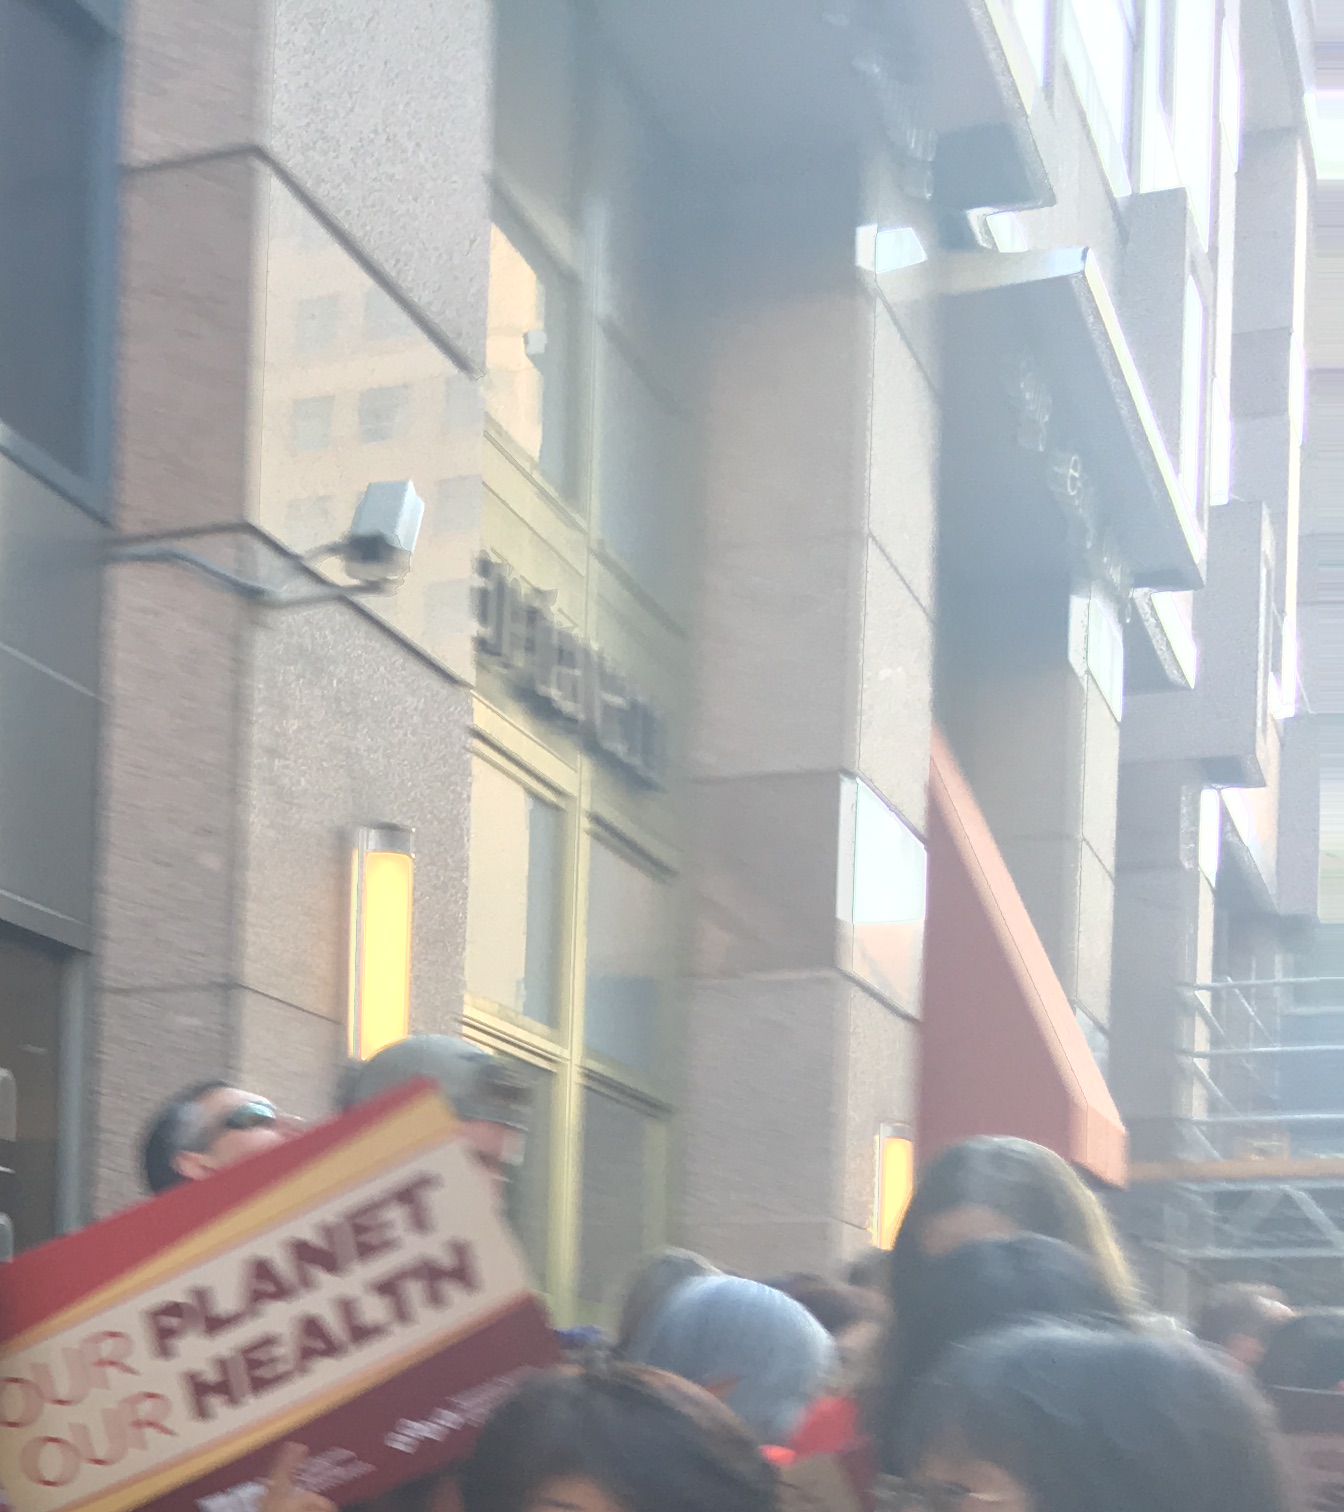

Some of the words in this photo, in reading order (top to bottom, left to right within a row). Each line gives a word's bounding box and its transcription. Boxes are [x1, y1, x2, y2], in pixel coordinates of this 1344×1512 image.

[19, 1391, 180, 1488] OUR
[183, 1237, 485, 1422] HEALTH
[145, 1170, 445, 1361] PLANET
